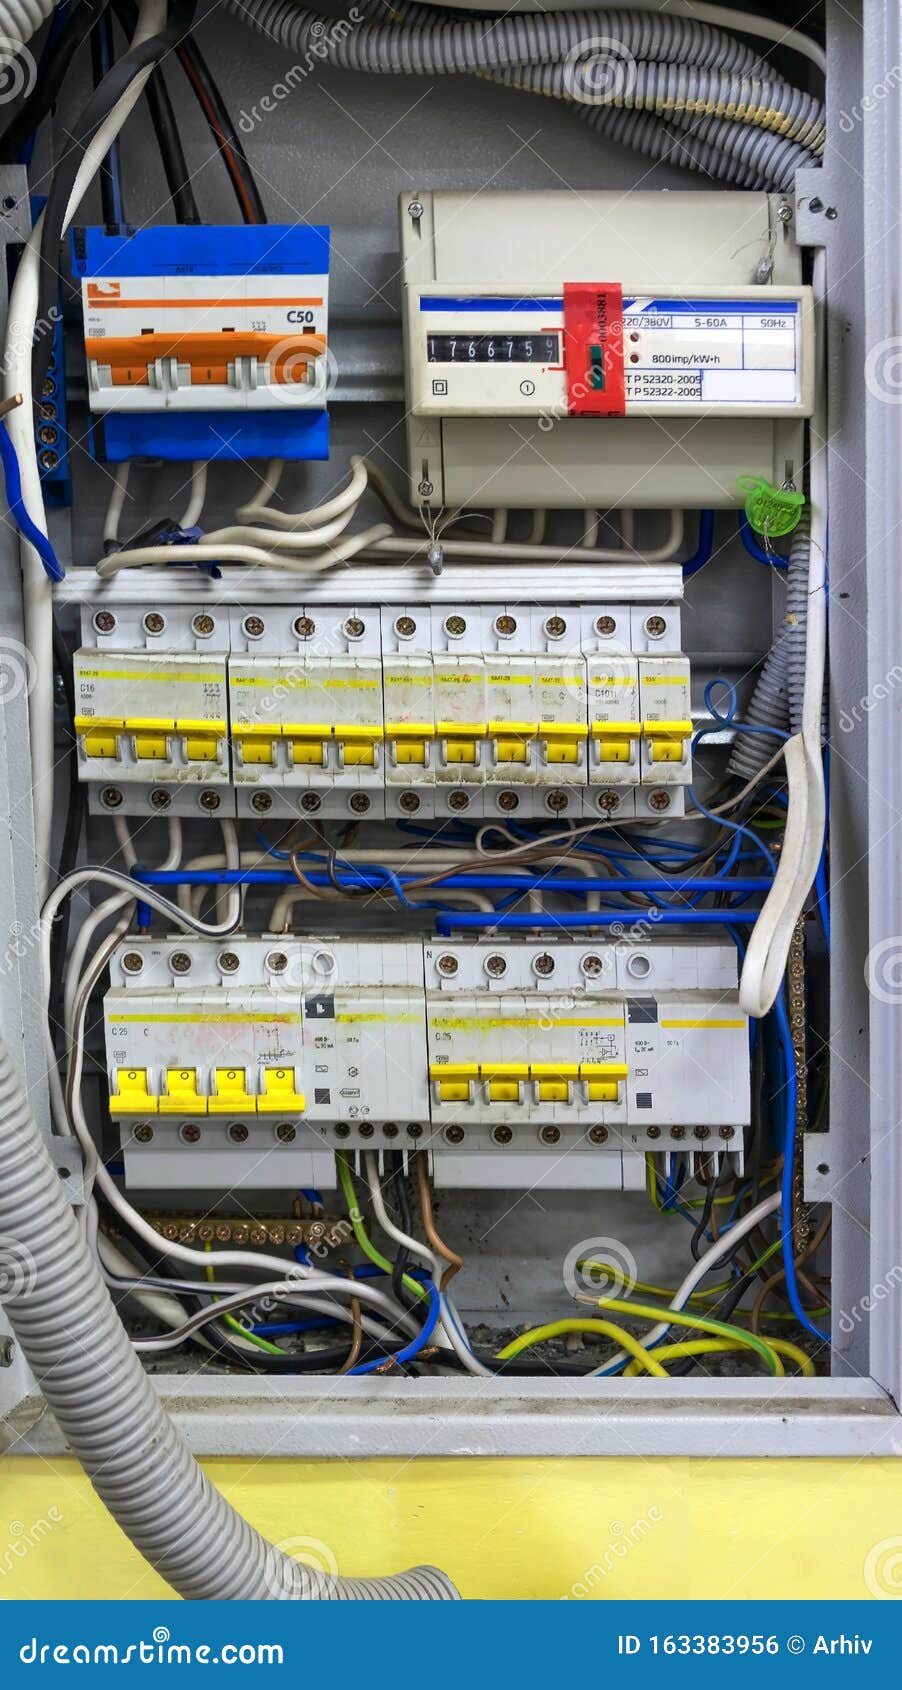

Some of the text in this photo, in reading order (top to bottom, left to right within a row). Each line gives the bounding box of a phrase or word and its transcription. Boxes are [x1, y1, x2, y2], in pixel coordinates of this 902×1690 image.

[286, 310, 314, 323] C50
[694, 318, 727, 328] 5-60A
[760, 318, 787, 328] 50Hz
[80, 683, 95, 693] C16
[426, 951, 433, 959] N
[320, 1128, 327, 1136] N
